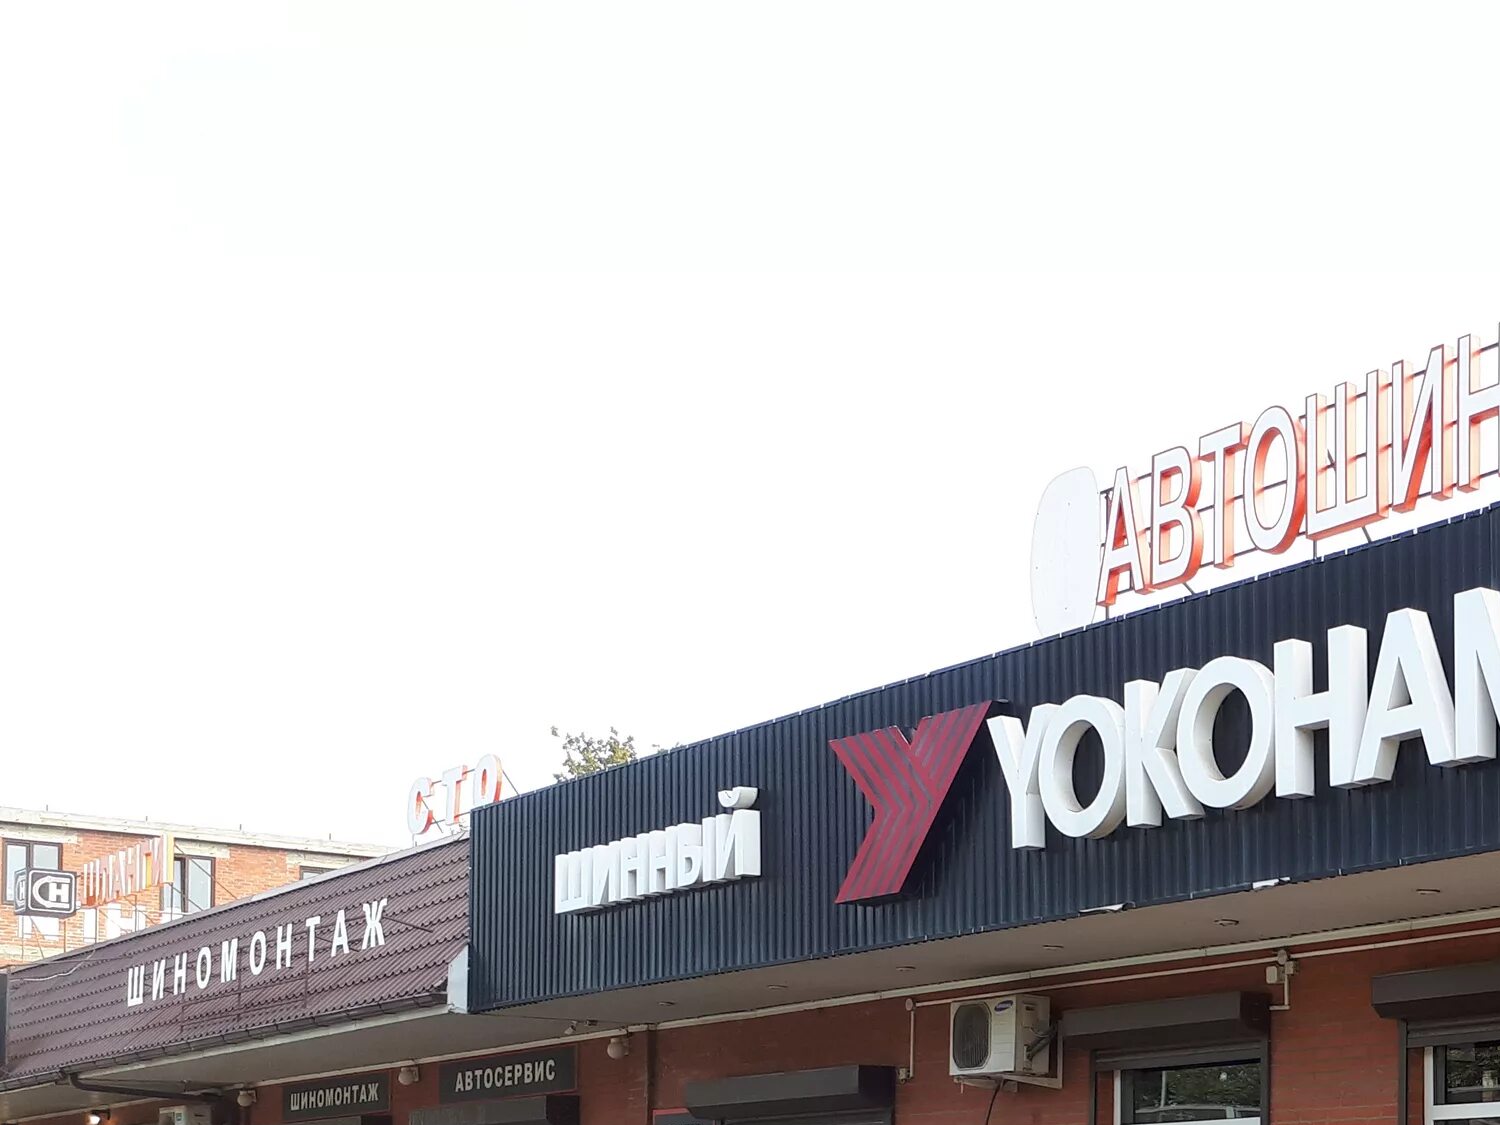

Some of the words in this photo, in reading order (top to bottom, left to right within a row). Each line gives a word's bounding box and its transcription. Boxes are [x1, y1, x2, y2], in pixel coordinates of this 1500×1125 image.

[407, 753, 502, 835] СТО
[554, 785, 761, 915] ШИННЫЙ
[127, 898, 388, 1007] ШИНОМОНТАЖ
[290, 1082, 379, 1111] ШИНОМОНТАЖ
[454, 1059, 556, 1092] АВТОСЕРВИС
